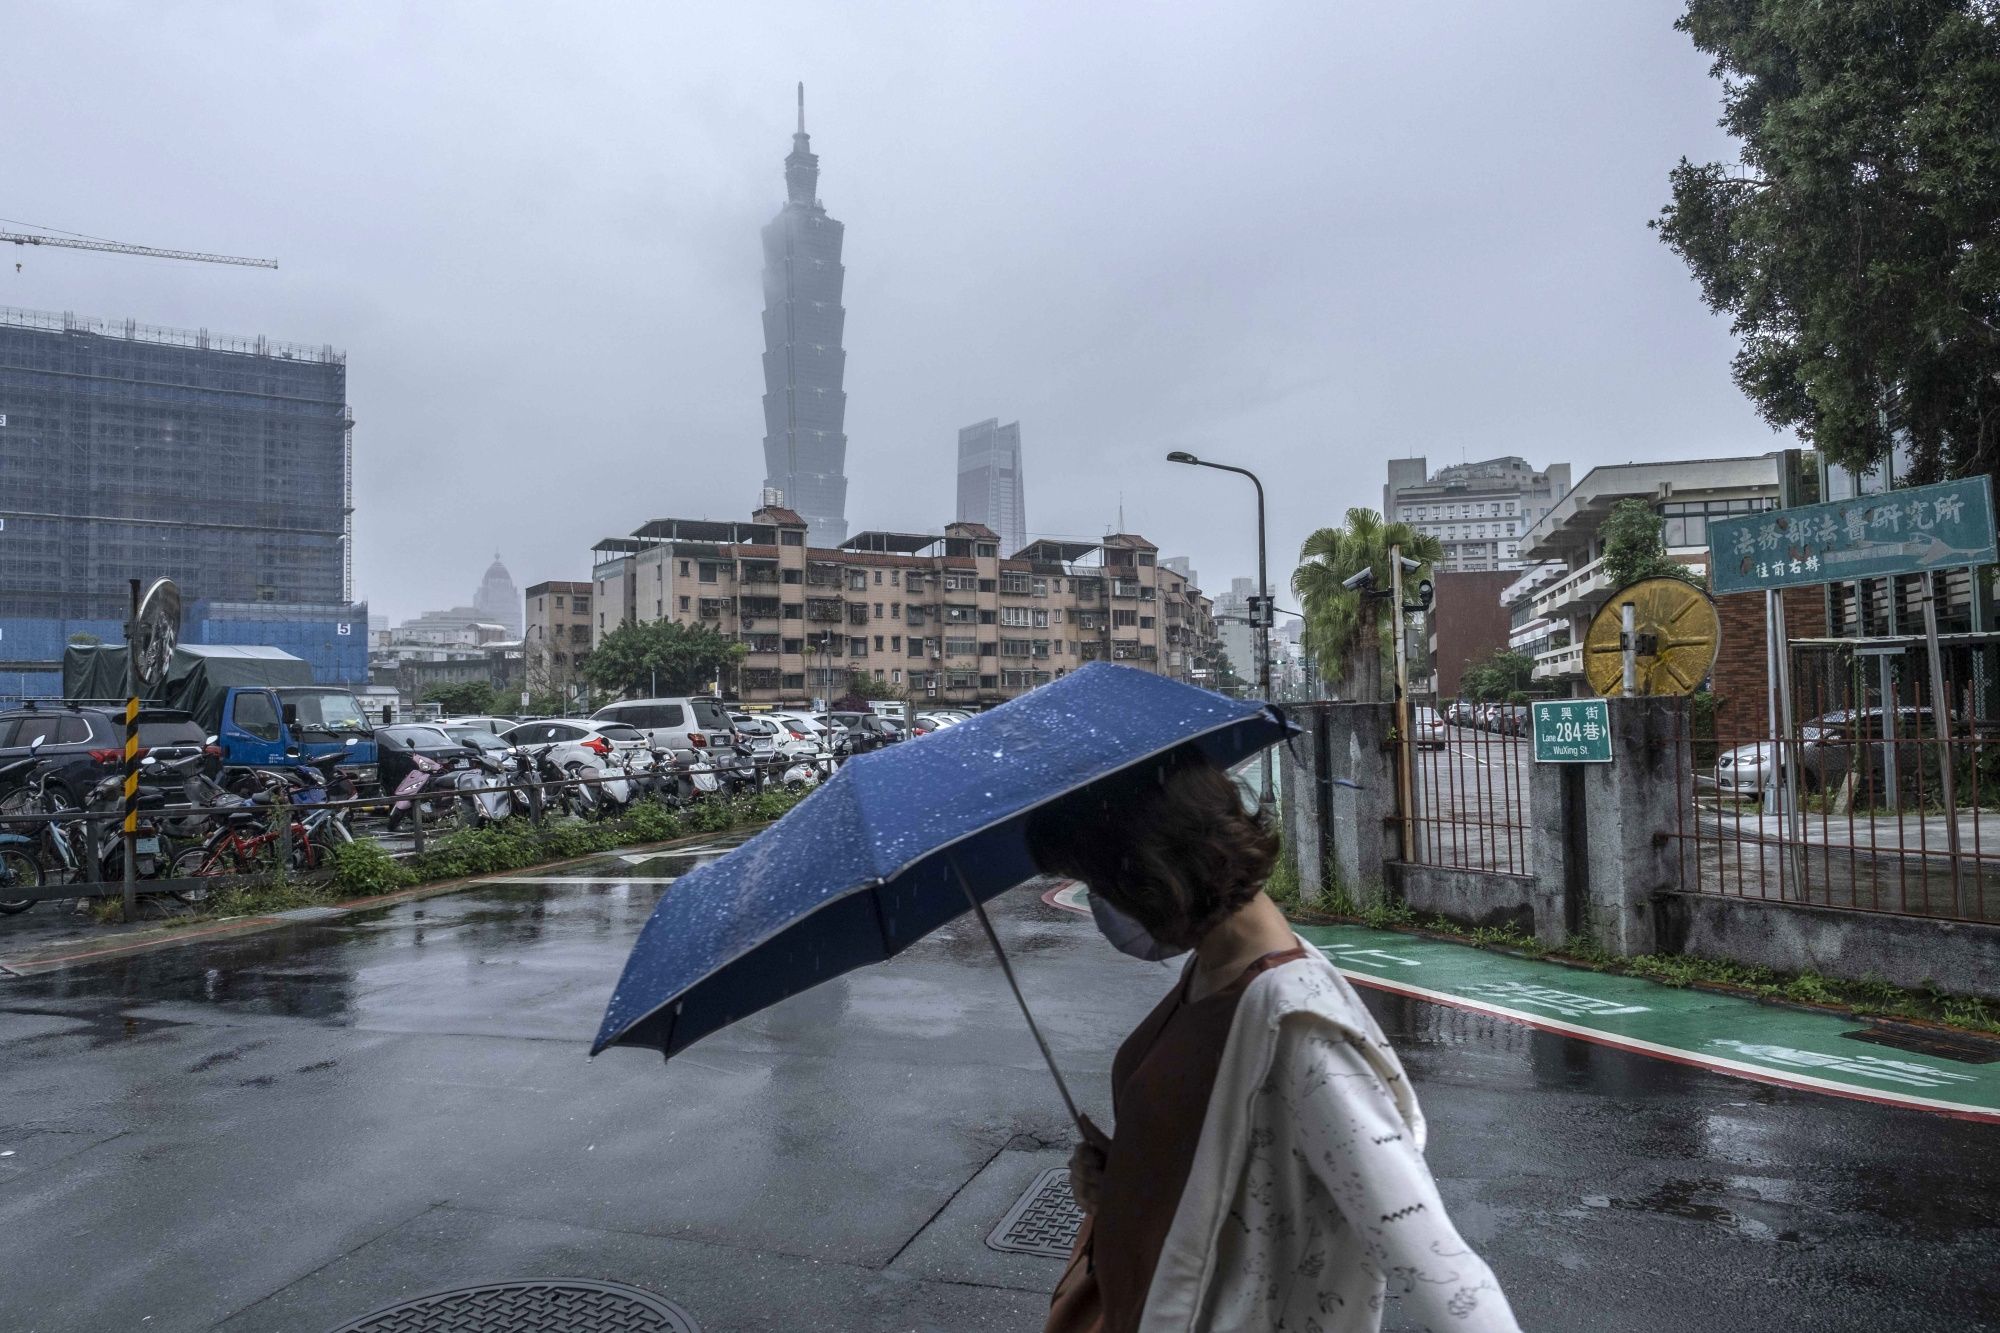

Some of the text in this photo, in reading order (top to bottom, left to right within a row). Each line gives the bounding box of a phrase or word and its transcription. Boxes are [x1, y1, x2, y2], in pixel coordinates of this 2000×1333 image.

[1756, 555, 1820, 578] 往前右轉
[340, 624, 349, 634] 5
[1541, 706, 1599, 721] 吳興街
[1542, 734, 1556, 742] Lane
[1553, 746, 1578, 756] WuXing
